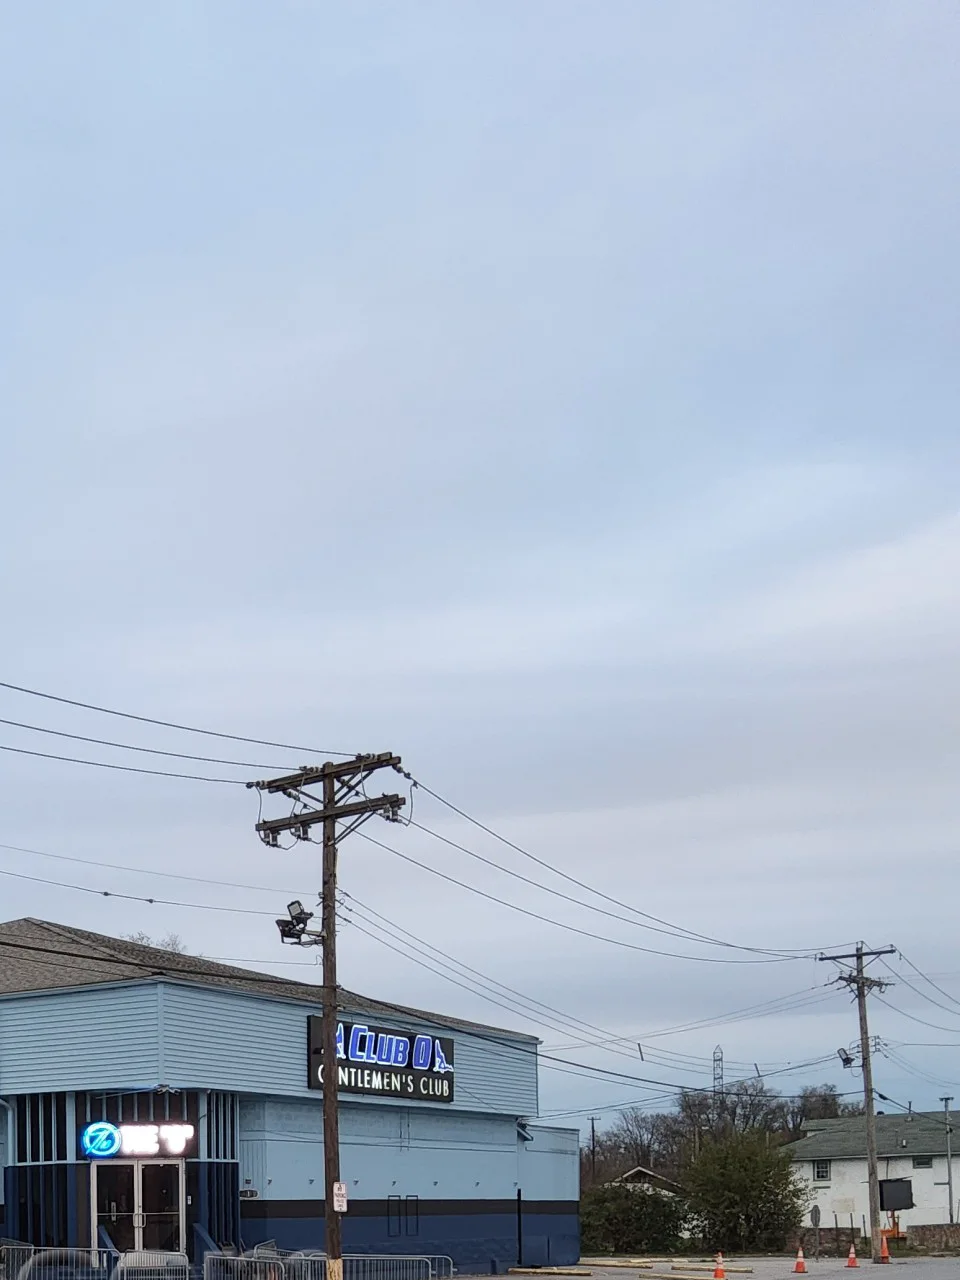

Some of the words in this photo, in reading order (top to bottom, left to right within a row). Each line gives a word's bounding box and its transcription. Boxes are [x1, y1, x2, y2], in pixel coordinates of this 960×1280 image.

[348, 1024, 410, 1067] CLUB
[412, 1035, 433, 1070] O
[420, 1077, 450, 1097] CLUB
